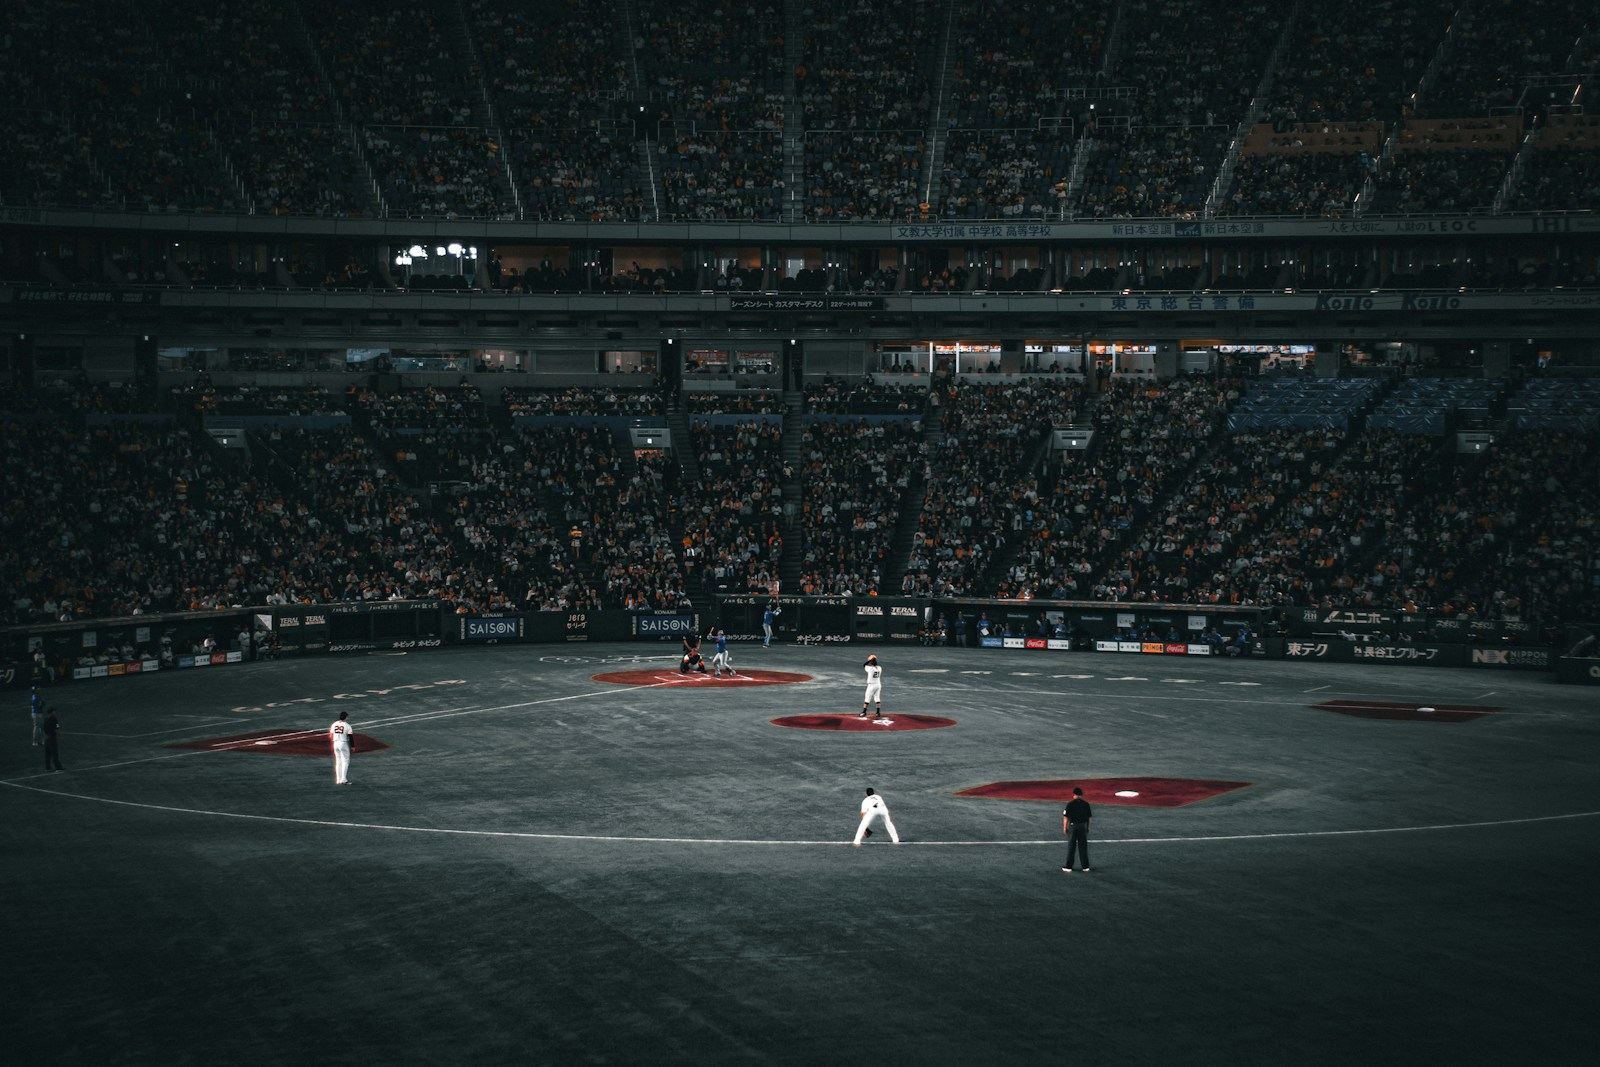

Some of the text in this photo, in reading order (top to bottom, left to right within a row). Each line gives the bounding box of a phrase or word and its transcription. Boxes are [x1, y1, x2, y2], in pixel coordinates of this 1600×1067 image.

[897, 226, 1051, 238] 文教大学付属 中学校 高等学校
[1112, 225, 1172, 236] 新日本空調
[1204, 224, 1265, 235] 新日本空調
[1428, 220, 1477, 232] LEOC
[731, 300, 774, 309] シーズンシート
[775, 300, 824, 309] カスタマーデスク
[1110, 295, 1255, 310] 東京総合警備
[469, 622, 516, 635] SAISON
[641, 620, 690, 631] SAISON
[1286, 642, 1328, 657] 東テク
[1364, 646, 1438, 660] 長谷工グループ
[1510, 650, 1548, 659] NIPPON
[1472, 649, 1509, 664] NX
[334, 725, 344, 734] 29
